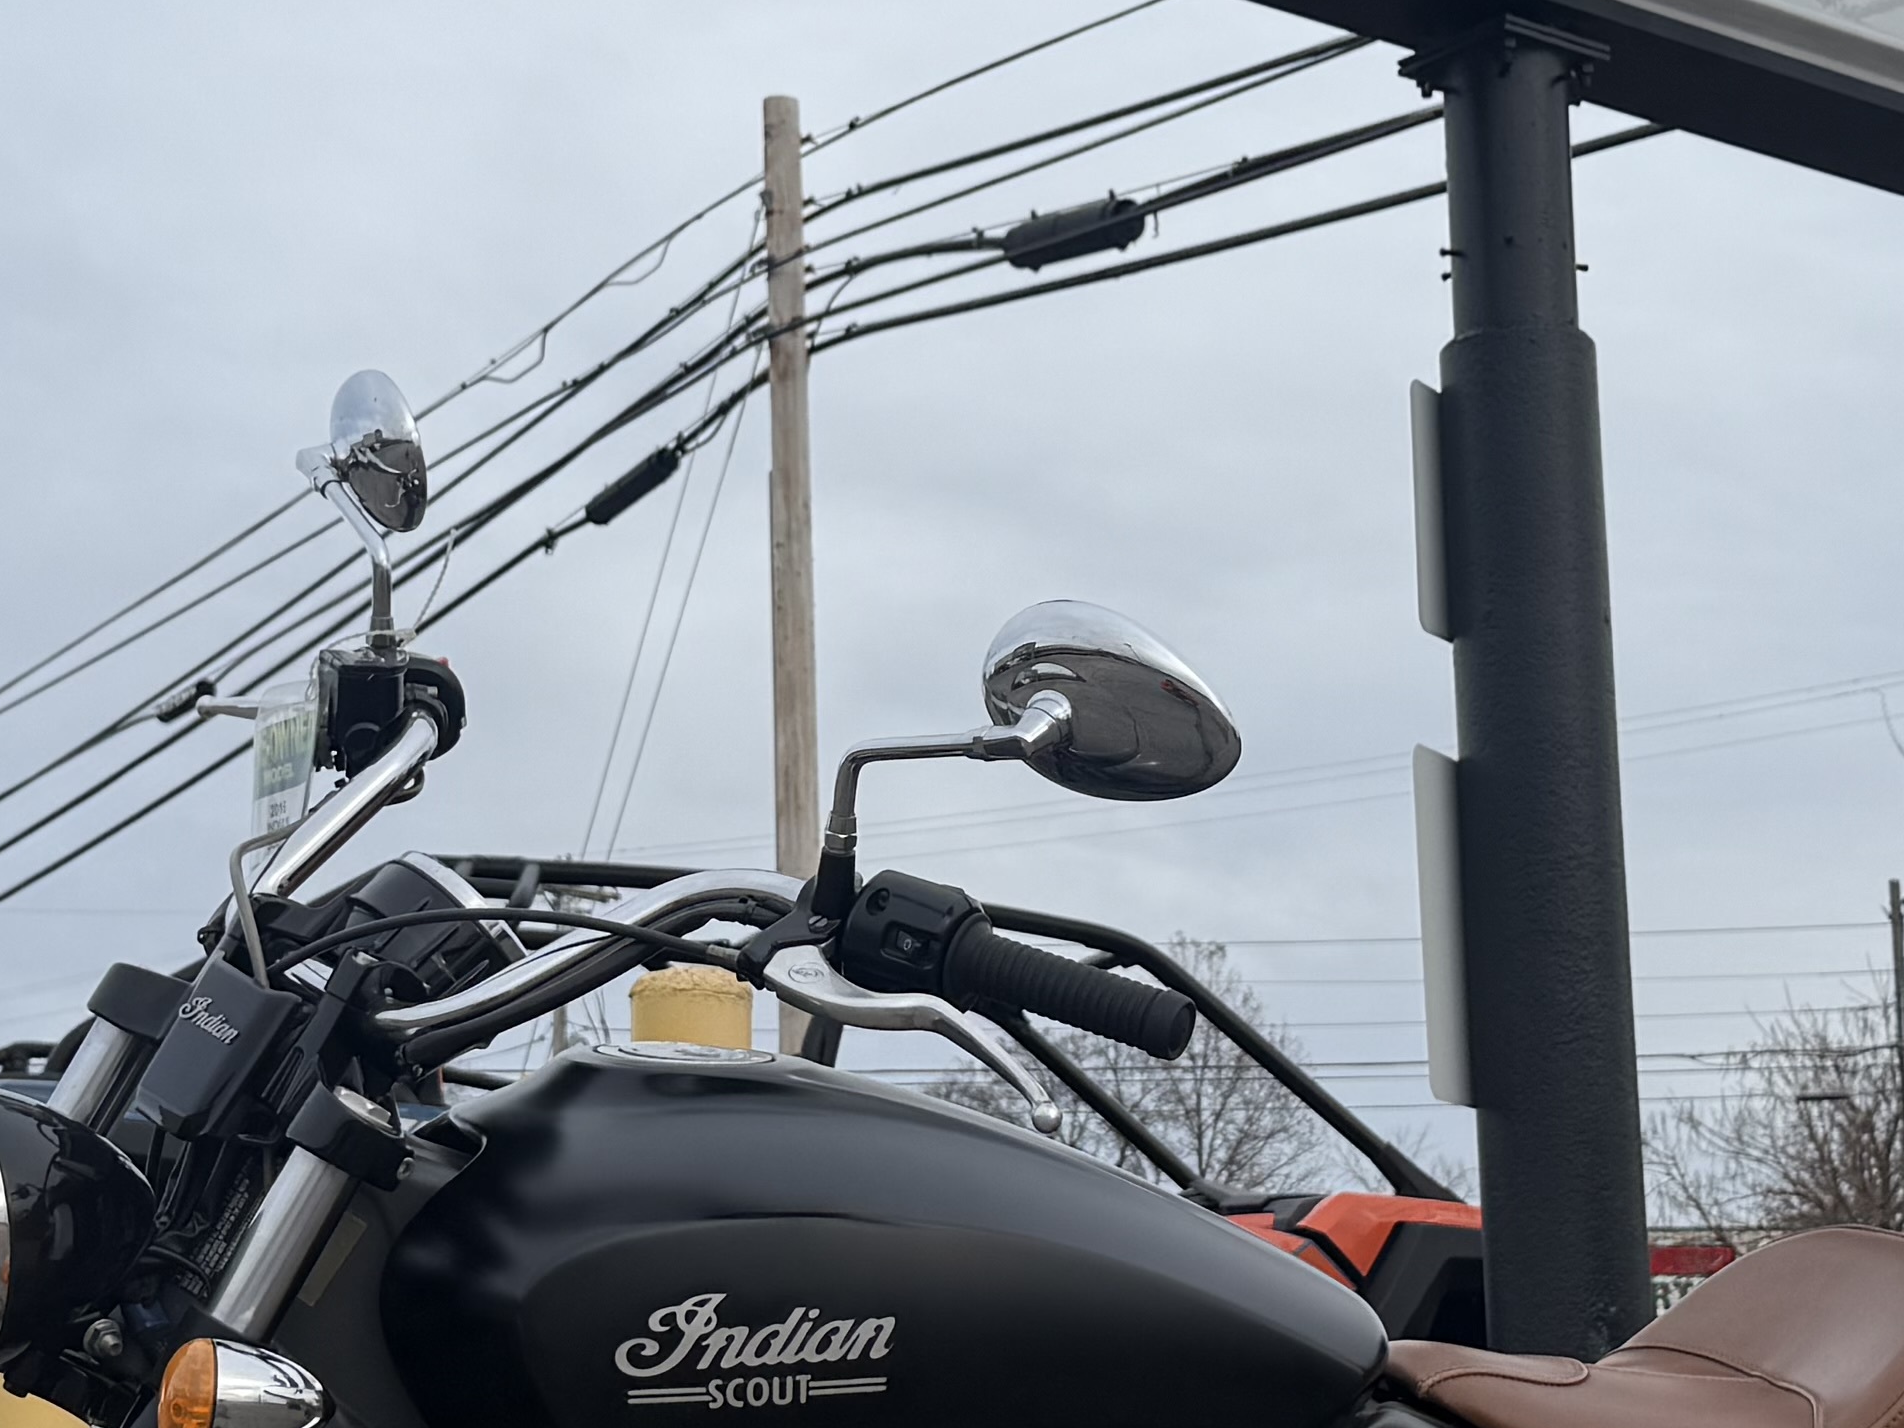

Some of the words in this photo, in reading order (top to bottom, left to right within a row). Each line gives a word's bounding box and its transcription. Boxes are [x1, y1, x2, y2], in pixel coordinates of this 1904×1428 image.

[178, 996, 239, 1044] Indian
[614, 1293, 897, 1377] Indian
[708, 1374, 812, 1410] SCOUT
